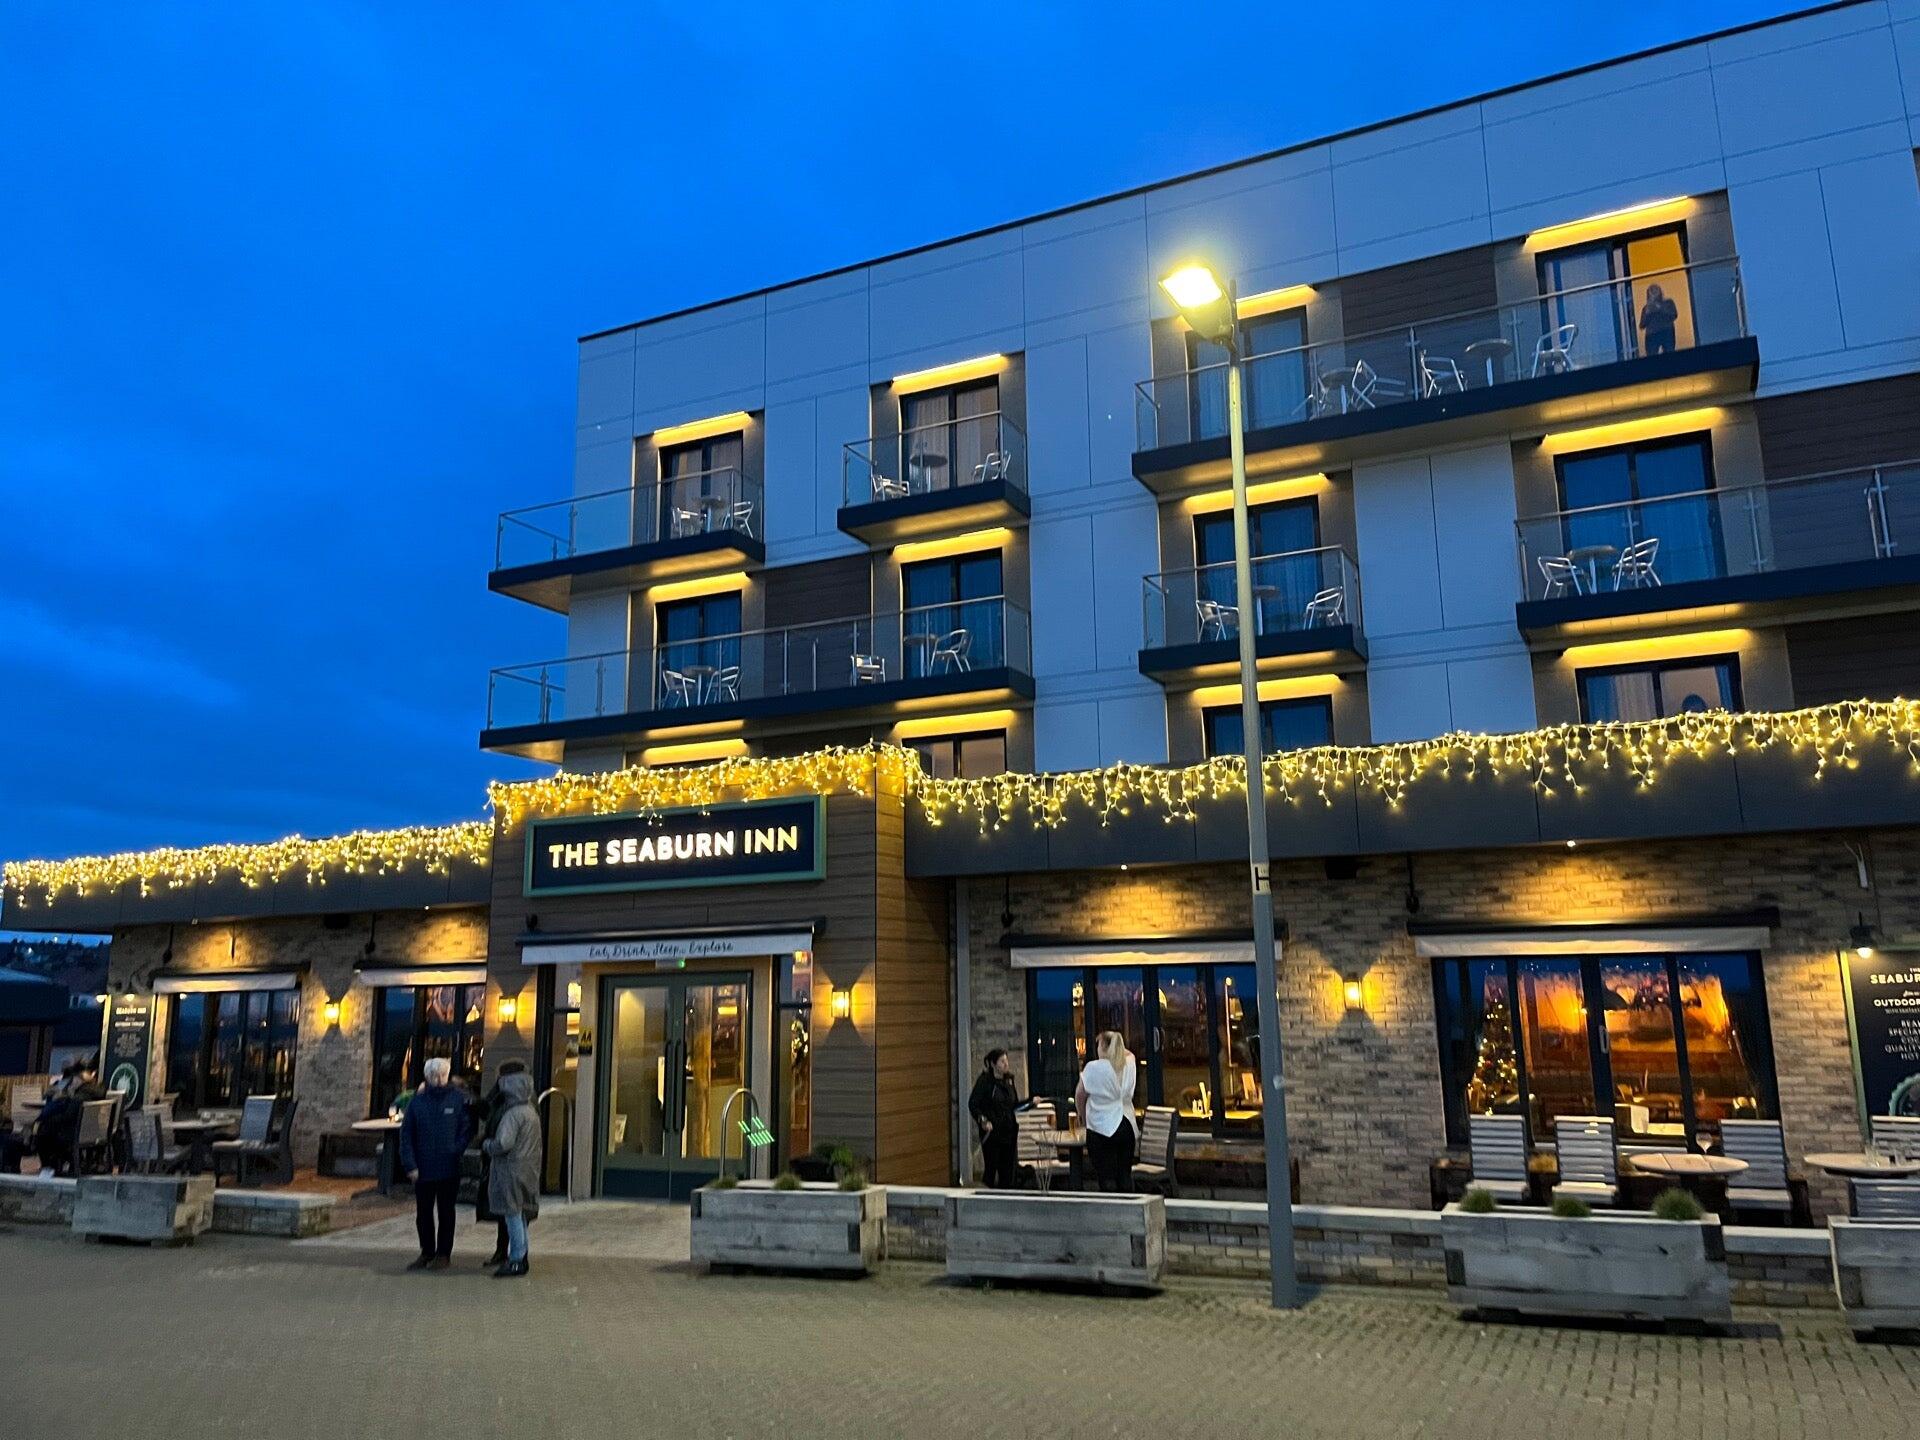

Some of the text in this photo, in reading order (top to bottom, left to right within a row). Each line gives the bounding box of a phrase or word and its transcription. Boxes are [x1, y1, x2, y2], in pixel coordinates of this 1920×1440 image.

[548, 825, 798, 868] THE SEABURN INN
[688, 939, 734, 956] Explore
